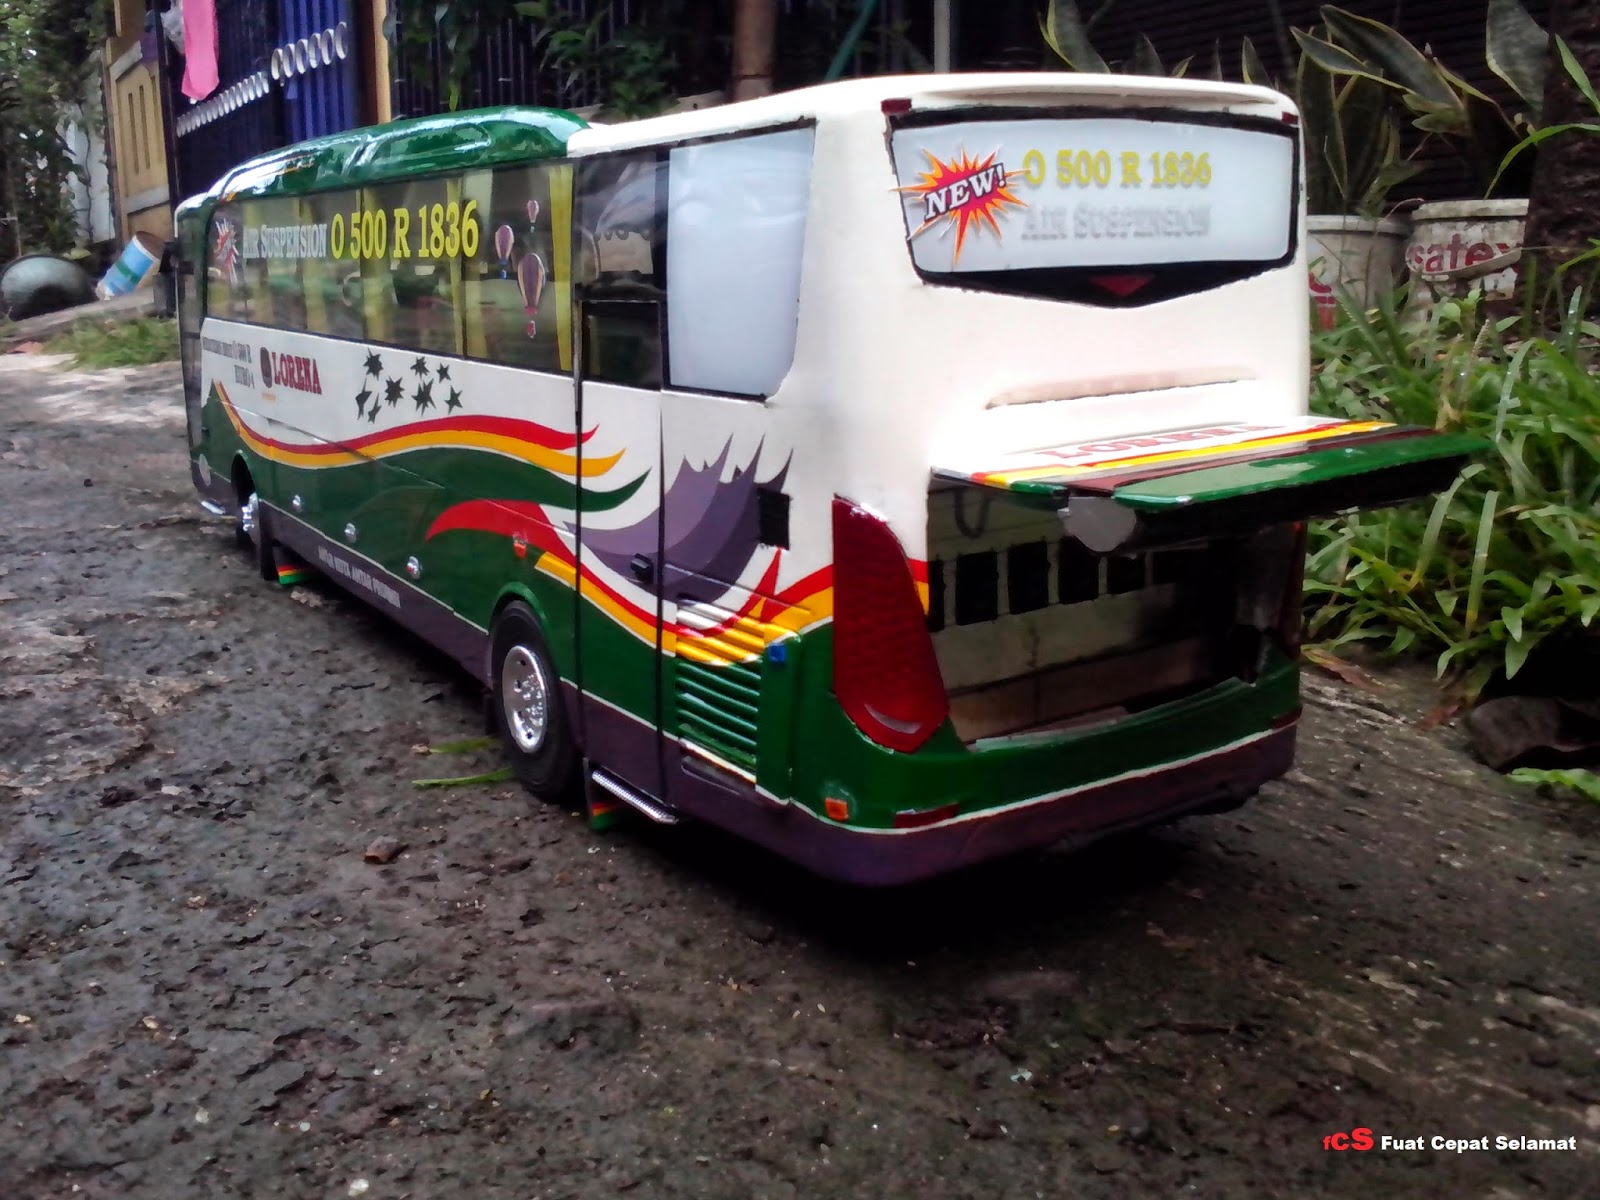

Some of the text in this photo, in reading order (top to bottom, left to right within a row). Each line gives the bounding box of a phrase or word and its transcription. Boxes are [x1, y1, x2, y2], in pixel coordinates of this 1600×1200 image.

[924, 163, 1006, 222] NEW!
[1056, 149, 1112, 186] 500
[1120, 151, 1142, 186] R
[1150, 151, 1213, 187] 1836
[350, 208, 388, 260] 500
[393, 207, 411, 258] R
[418, 199, 480, 259] 1836
